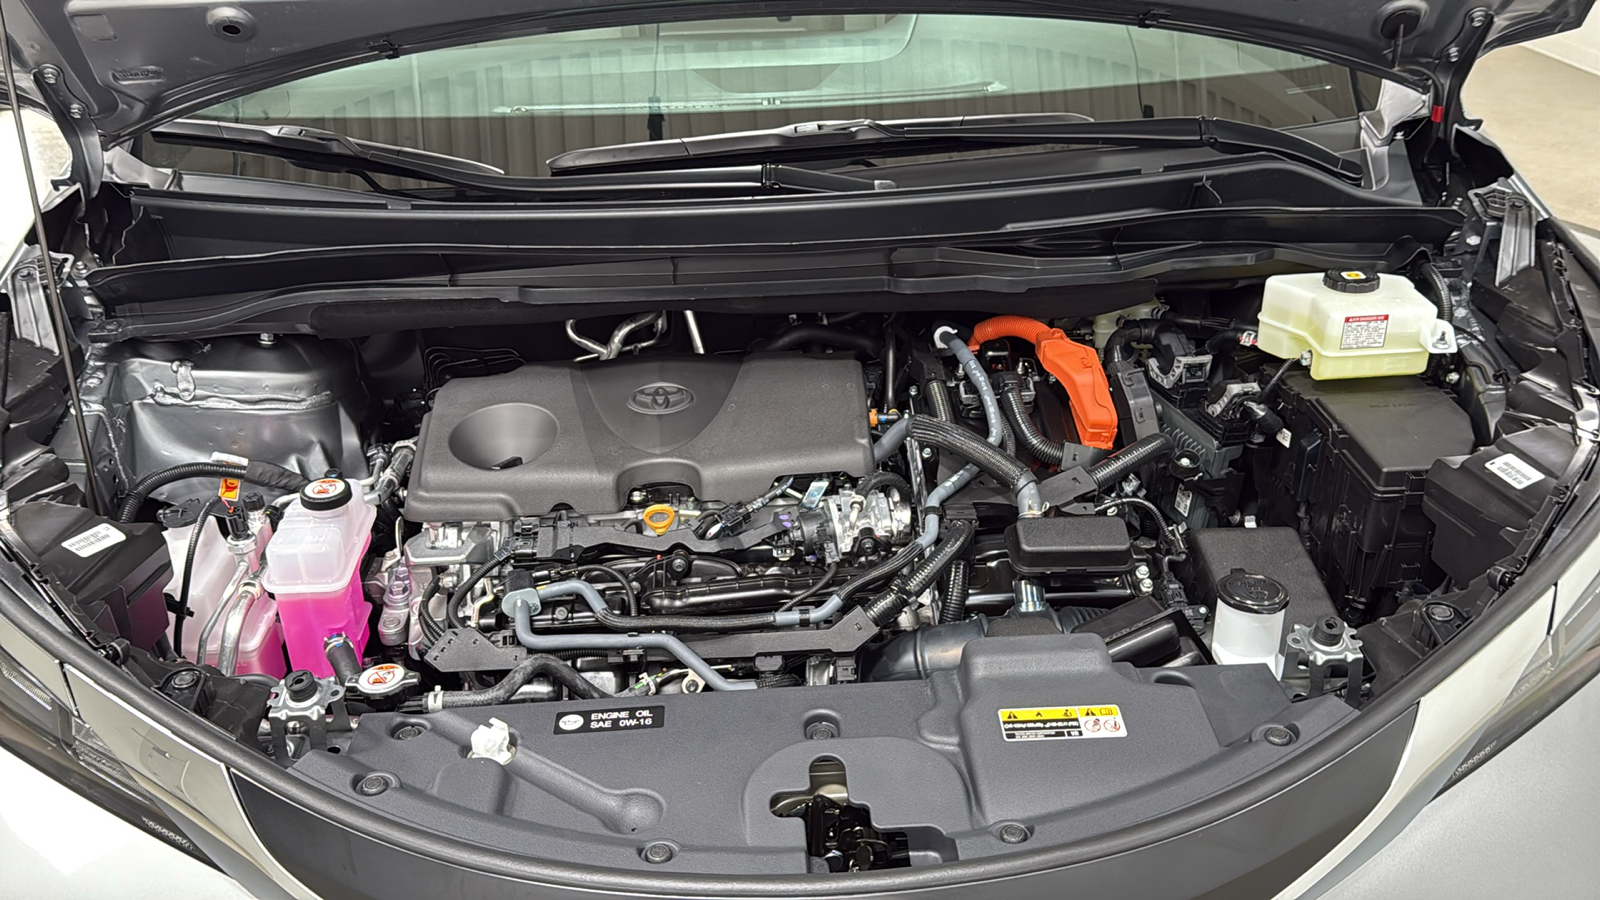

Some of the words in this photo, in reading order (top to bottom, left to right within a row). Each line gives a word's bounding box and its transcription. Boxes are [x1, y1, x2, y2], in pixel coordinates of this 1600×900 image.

[591, 711, 630, 720] ENGINE
[635, 709, 653, 717] OIL
[590, 720, 612, 729] SAE
[619, 717, 652, 727] 0W-16
